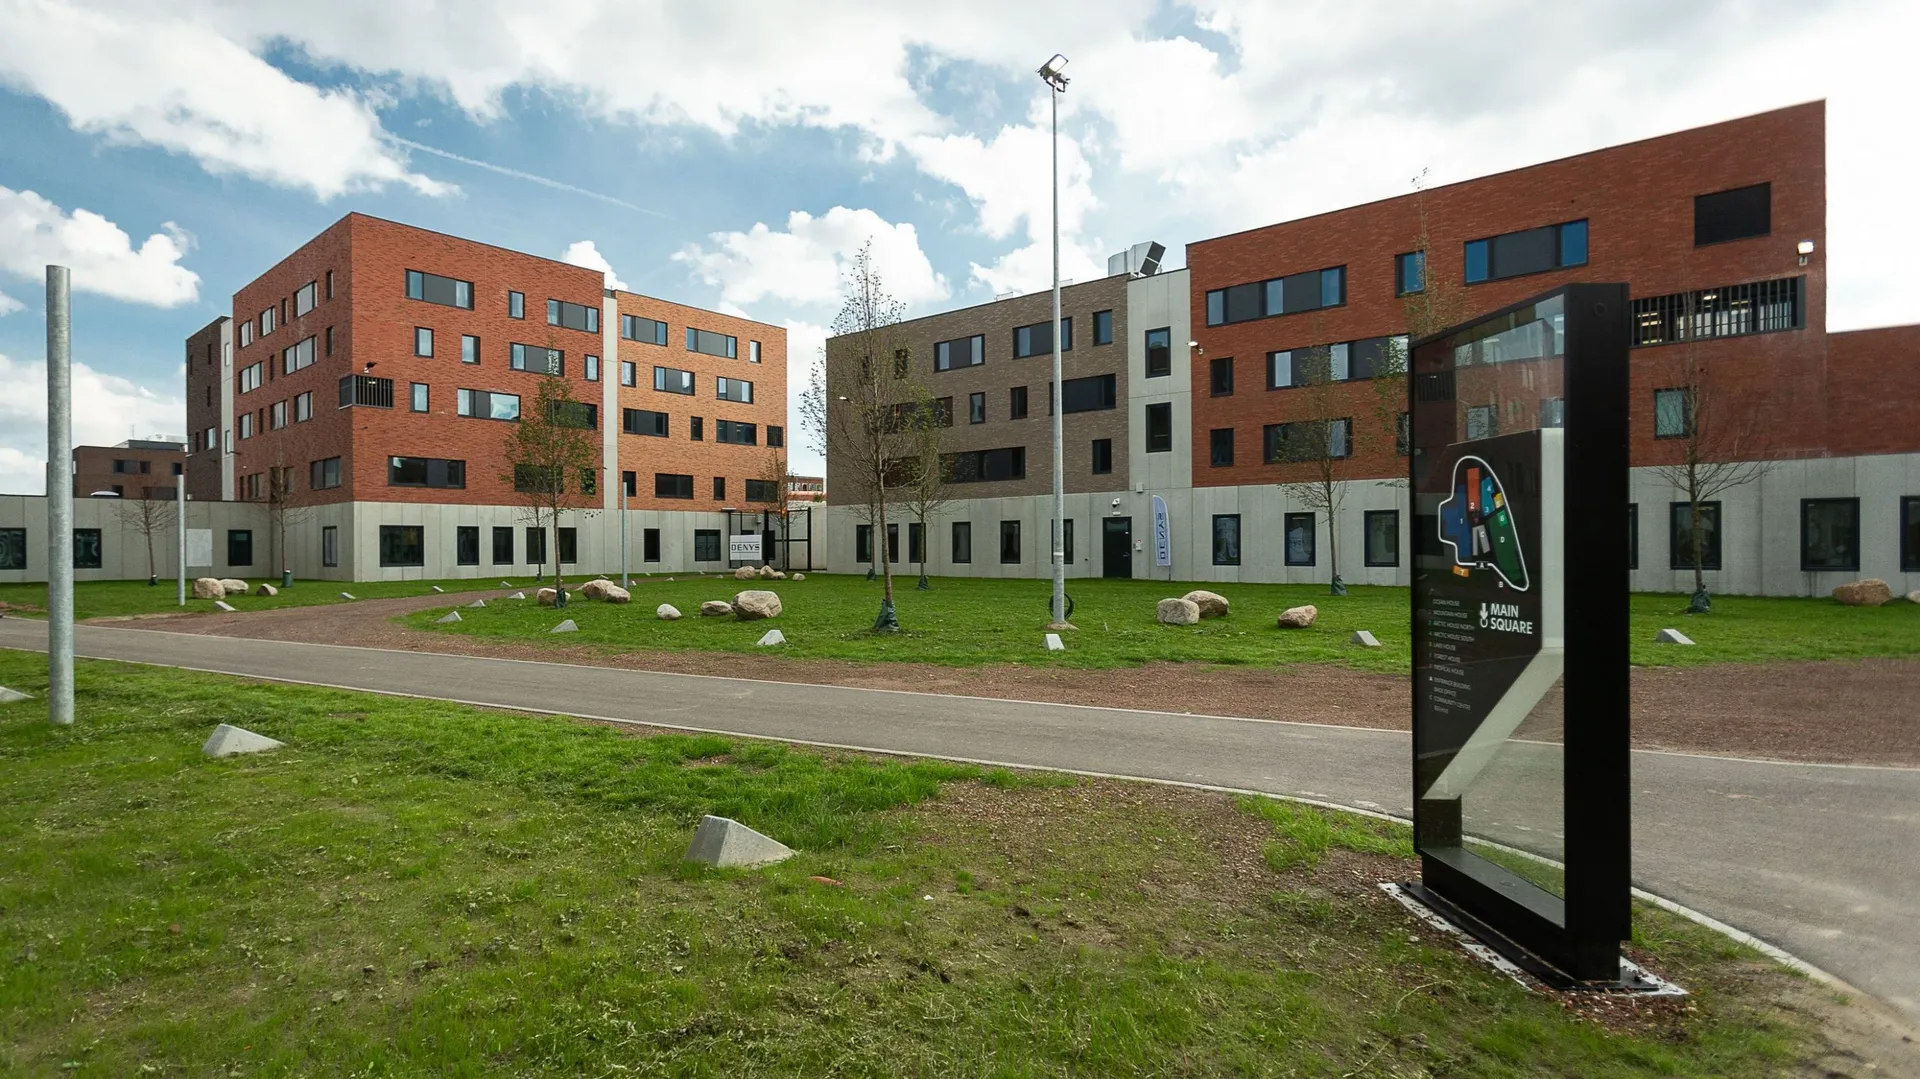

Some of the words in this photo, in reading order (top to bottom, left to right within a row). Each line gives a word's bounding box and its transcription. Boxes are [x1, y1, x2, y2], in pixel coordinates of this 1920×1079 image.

[731, 543, 760, 551] DENYS
[1490, 603, 1519, 618] MAIN
[1490, 618, 1533, 634] SQUARE
[1451, 668, 1464, 676] HOUSE
